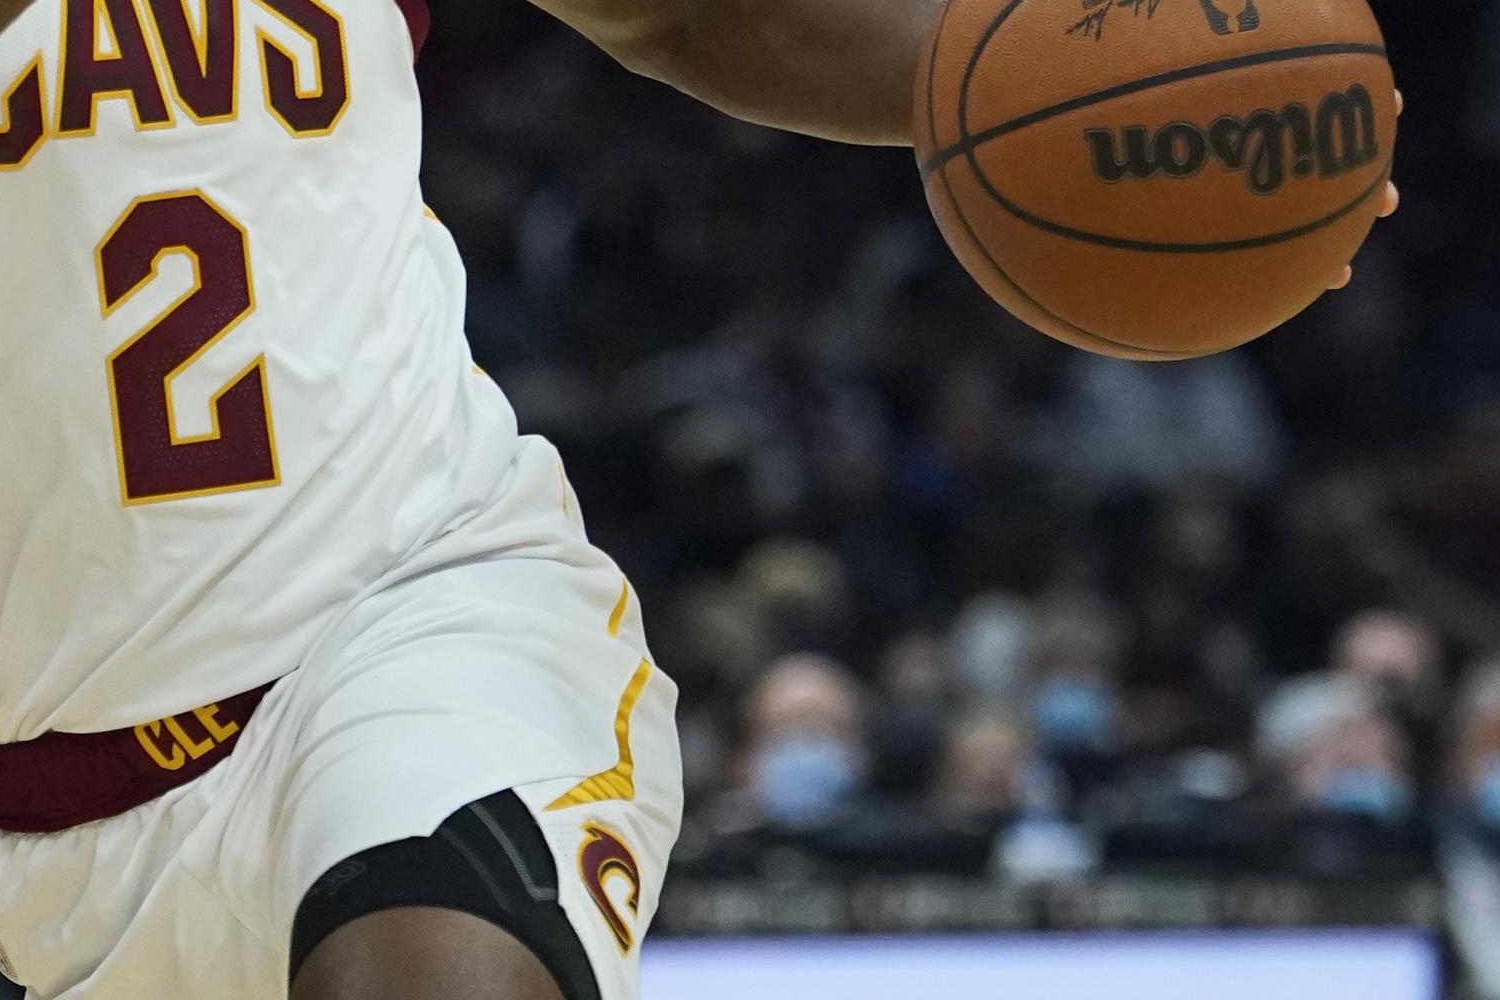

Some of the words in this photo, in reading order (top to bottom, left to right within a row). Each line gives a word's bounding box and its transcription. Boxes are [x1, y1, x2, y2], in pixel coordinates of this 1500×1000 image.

[1083, 83, 1379, 195] Wilson
[93, 187, 283, 508] 2
[133, 703, 240, 771] CLE
